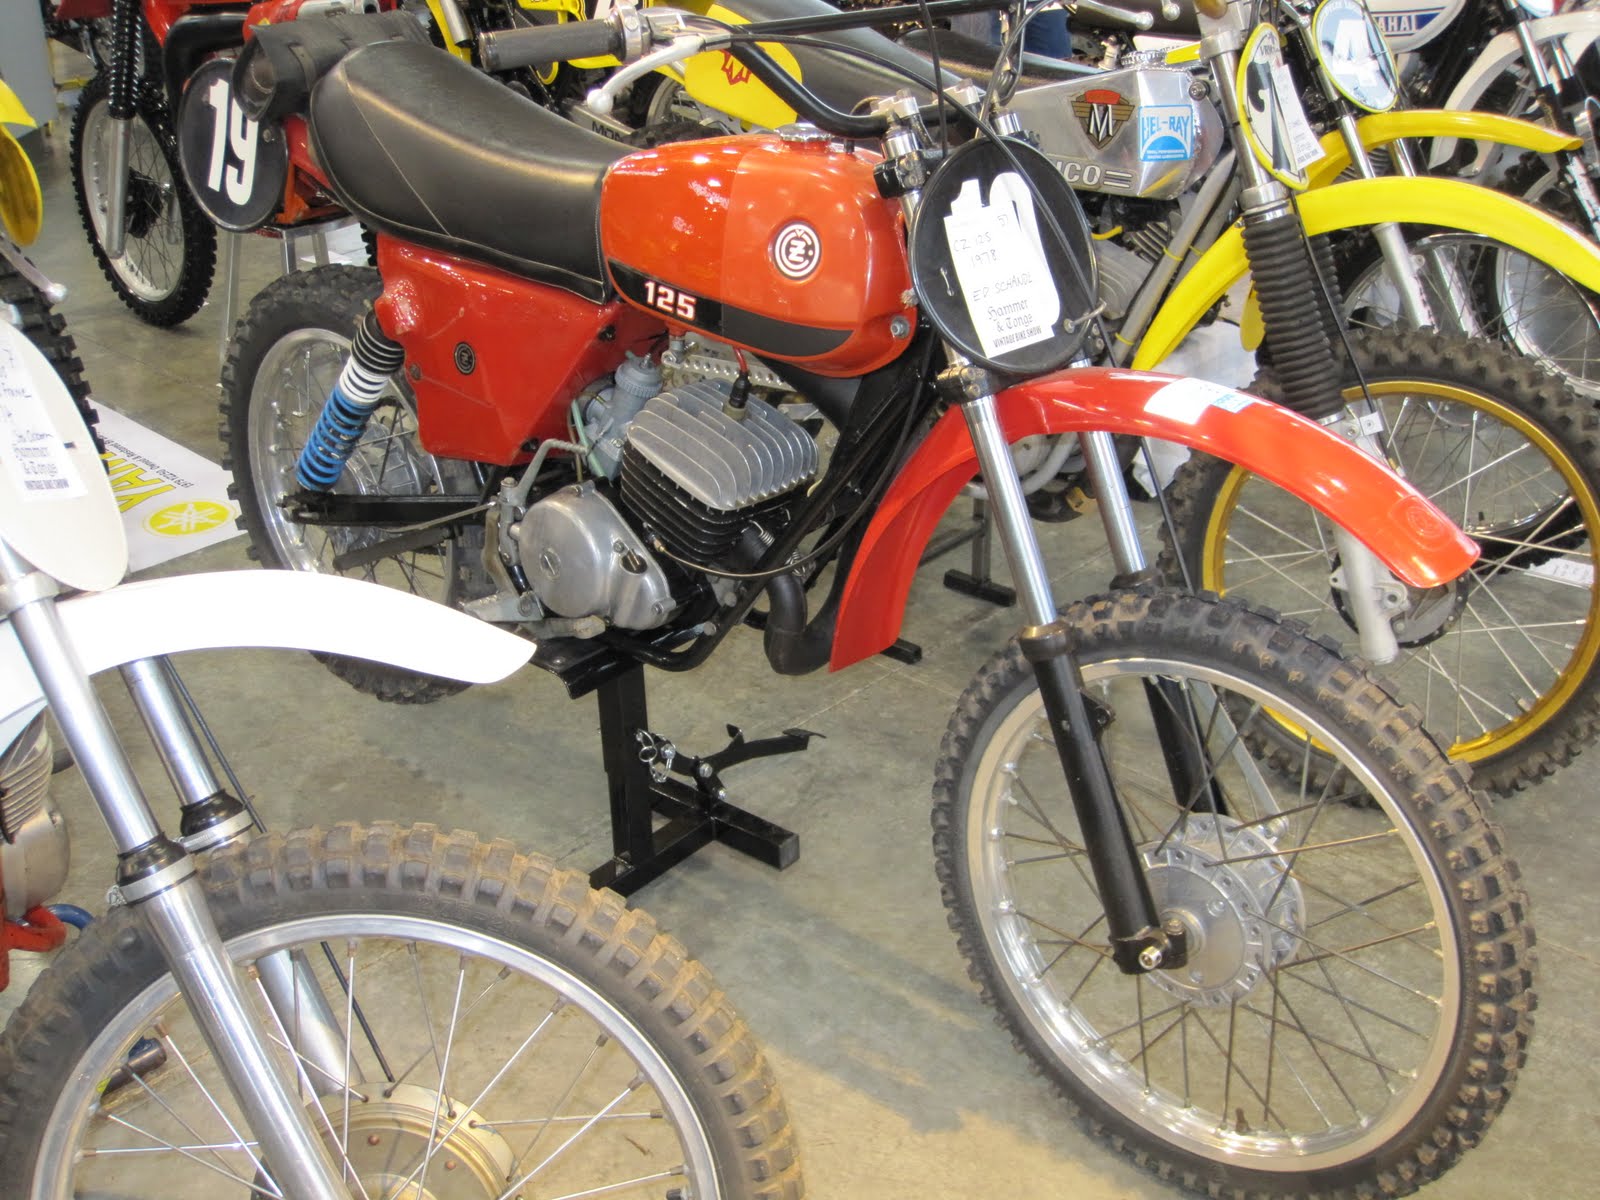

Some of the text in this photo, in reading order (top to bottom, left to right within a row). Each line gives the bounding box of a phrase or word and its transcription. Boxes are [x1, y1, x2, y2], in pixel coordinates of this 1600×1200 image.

[1377, 16, 1410, 32] AHA
[208, 78, 259, 206] 19
[971, 249, 997, 269] 1978
[644, 279, 697, 321] 125
[973, 287, 989, 302] ED
[987, 299, 1028, 321] Hammer
[993, 325, 1042, 348] VINTAGE BIKE SHOW
[997, 320, 1004, 332] &
